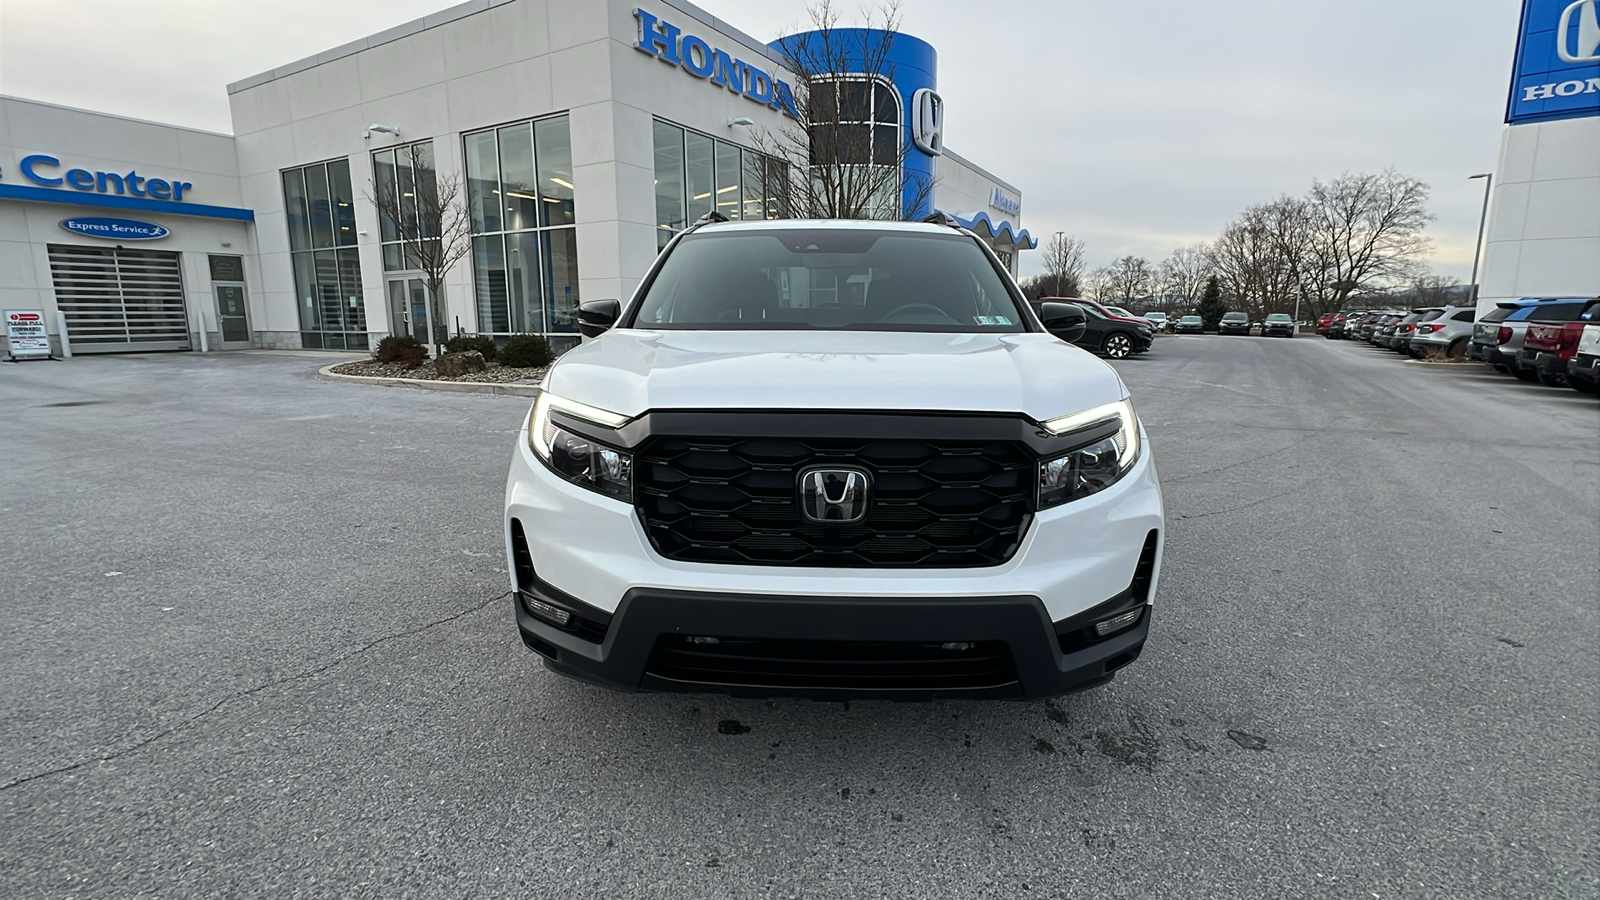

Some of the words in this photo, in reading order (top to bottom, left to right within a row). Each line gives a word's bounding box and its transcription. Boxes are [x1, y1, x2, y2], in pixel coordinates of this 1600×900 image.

[633, 8, 800, 118] HONDA
[20, 154, 192, 201] Center
[68, 221, 109, 231] Express
[112, 224, 149, 233] Service
